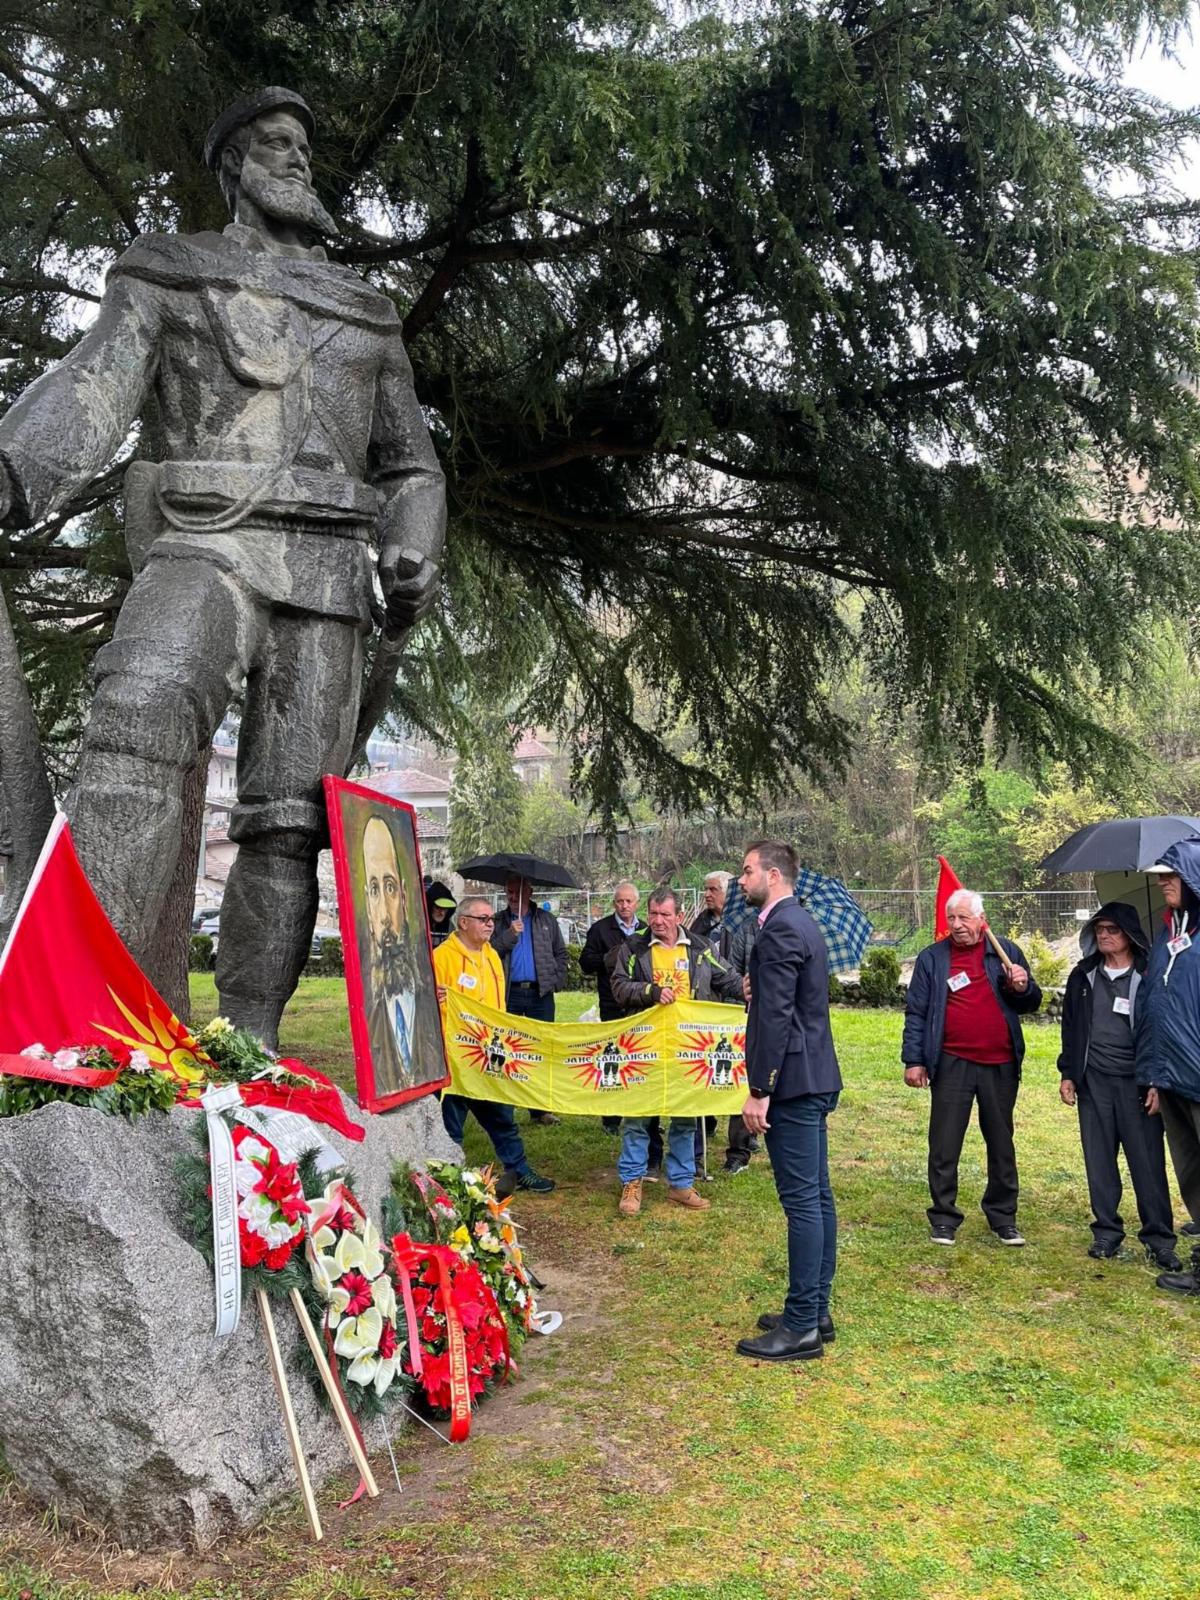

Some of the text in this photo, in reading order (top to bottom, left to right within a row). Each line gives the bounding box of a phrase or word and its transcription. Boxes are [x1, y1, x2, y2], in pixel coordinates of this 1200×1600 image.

[596, 1052, 657, 1063] САНДАНСКИ
[707, 1051, 745, 1060] САНДА
[216, 1162, 233, 1231] САНДАНСКИ
[220, 1233, 237, 1277] ЯНЕ
[454, 1383, 466, 1396] ОТ
